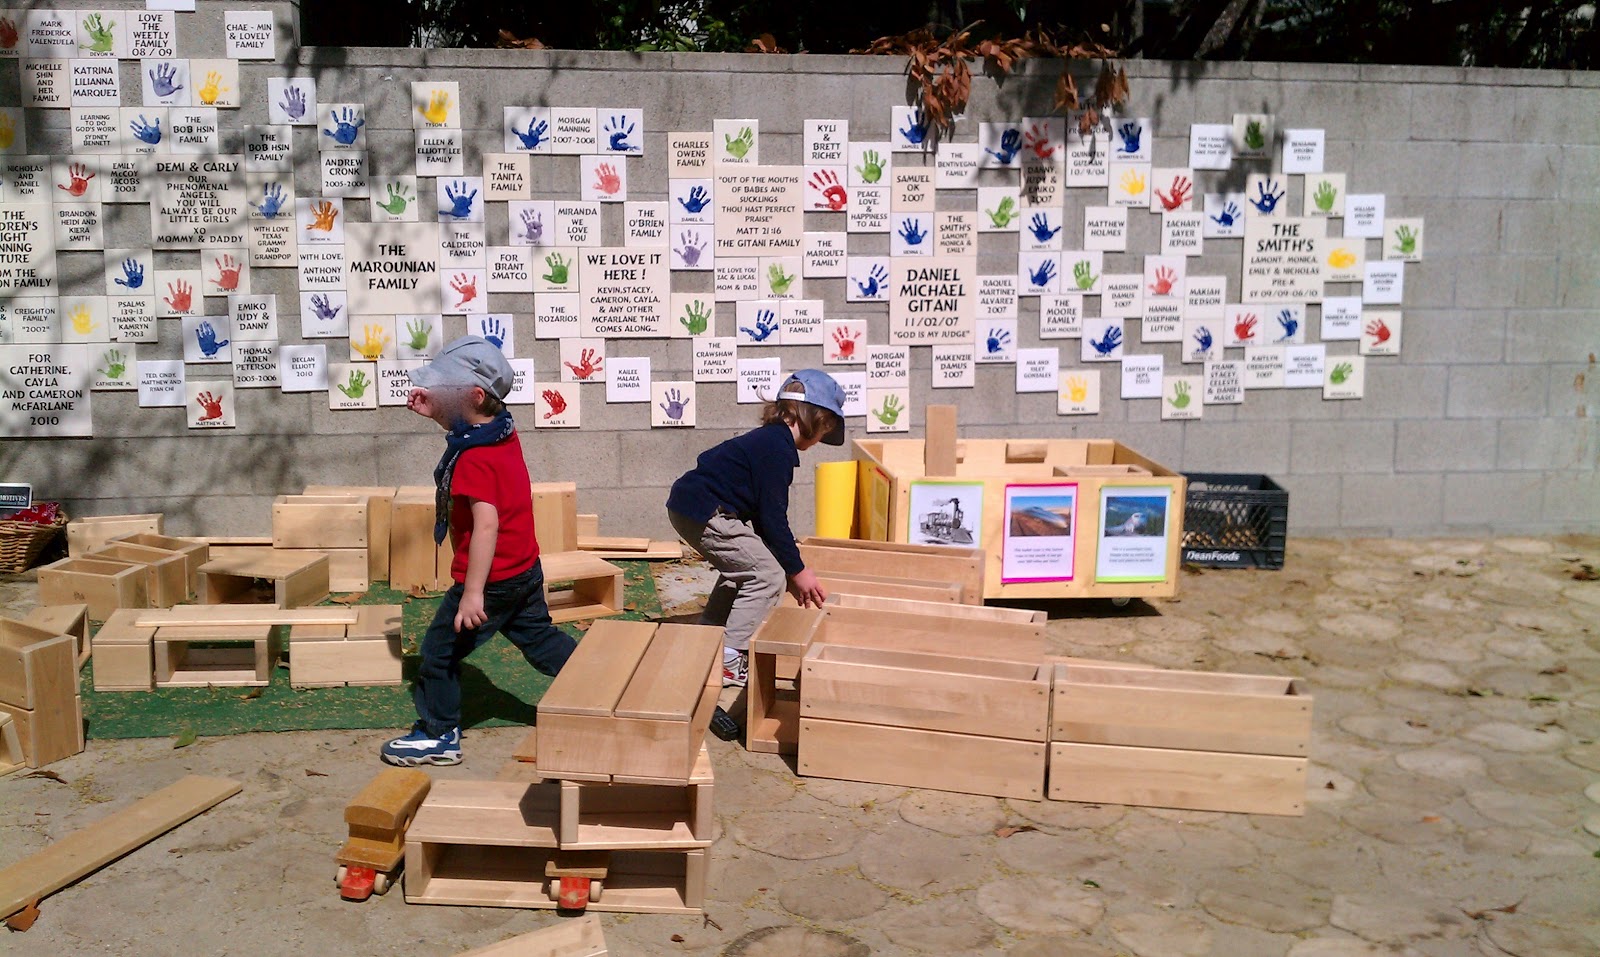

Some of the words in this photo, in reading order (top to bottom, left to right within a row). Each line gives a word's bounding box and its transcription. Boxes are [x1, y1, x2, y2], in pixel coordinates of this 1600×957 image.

[138, 14, 163, 22] LOVE
[142, 22, 160, 31] THE
[133, 31, 170, 39] WEETLY
[135, 39, 168, 47] FAMILY
[131, 48, 146, 57] 08
[158, 48, 173, 57] 09
[74, 66, 113, 74] KATRINA
[73, 89, 117, 98] MARQUEZ
[817, 124, 836, 132] KYLI
[179, 136, 209, 144] FAMILY
[823, 134, 830, 142] &
[673, 141, 709, 149] CHARLES
[813, 143, 841, 151] BRETT
[677, 150, 705, 158] OWENS
[812, 152, 841, 160] RICHEY
[325, 158, 363, 166] ANDREW
[677, 159, 706, 167] FAMILY
[157, 163, 185, 172] DEMI
[190, 163, 199, 172] &
[203, 162, 239, 172] CARLY
[329, 168, 360, 176] CRONK
[188, 175, 207, 183] OUR
[491, 173, 523, 181] TANITA
[768, 176, 798, 184] MOUTHS
[896, 175, 930, 183] SAMUEL
[167, 183, 228, 191] PHENOMENAL
[491, 183, 523, 192] FAMILY
[740, 195, 778, 203] SUCKLINGS
[902, 194, 924, 202] 2007
[177, 199, 196, 207] YOU
[199, 199, 220, 207] WILL
[161, 207, 197, 215] ALWAYS
[558, 208, 597, 216] MIRANDA
[170, 215, 200, 223] LITTLE
[203, 215, 229, 223] GIRLS
[629, 219, 664, 228] O'BRIEN
[631, 229, 662, 237] FAMILY
[736, 227, 760, 235] MATT
[1272, 224, 1299, 235] THE
[157, 235, 194, 243] MOMMY
[197, 235, 205, 243] &
[210, 235, 244, 243] DADDY
[454, 232, 469, 240] THE
[441, 241, 484, 249] CALDERON
[717, 239, 734, 248] THE
[737, 239, 766, 247] GITANI
[769, 239, 801, 248] FAMILY
[817, 240, 832, 248] THE
[1257, 240, 1314, 252] SMITH'S
[379, 245, 406, 256] THE
[449, 249, 477, 257] FAMILY
[806, 249, 844, 258] MARQUEZ
[587, 255, 608, 264] WE
[611, 254, 645, 264] LOVE
[649, 254, 661, 264] IT
[811, 259, 840, 267] FAMILY
[350, 261, 435, 273] MAROUNIAN
[495, 263, 524, 271] BRANT
[1249, 267, 1270, 275] EMILY
[1274, 267, 1281, 275] &
[1283, 267, 1319, 275] NICHOLAS
[491, 272, 527, 280] SMATCO
[604, 270, 637, 280] HERE
[907, 269, 960, 282] DANIEL
[369, 278, 419, 290] FAMILY
[900, 284, 966, 297] MICHAEL
[590, 296, 631, 304] CAMERON,
[626, 305, 653, 313] OTHER
[908, 299, 958, 312] GITANI
[538, 315, 578, 323] ROZARIOS
[592, 315, 638, 323] MCFARLANE
[640, 315, 660, 323] THAT
[782, 317, 821, 325] DESJARLAIS
[905, 317, 959, 327] 11/02/07
[595, 325, 622, 333] COMES
[789, 326, 813, 334] FAMILY
[29, 354, 51, 363] FOR
[940, 362, 967, 370] DAMUS
[10, 366, 71, 375] CATHERINE,
[25, 378, 58, 387] CAYLA
[2, 390, 25, 399] AND
[29, 389, 82, 399] CAMERON
[11, 402, 74, 411] McFARLANE
[30, 416, 59, 426] 2010
[1186, 550, 1240, 561] DeanFoods
